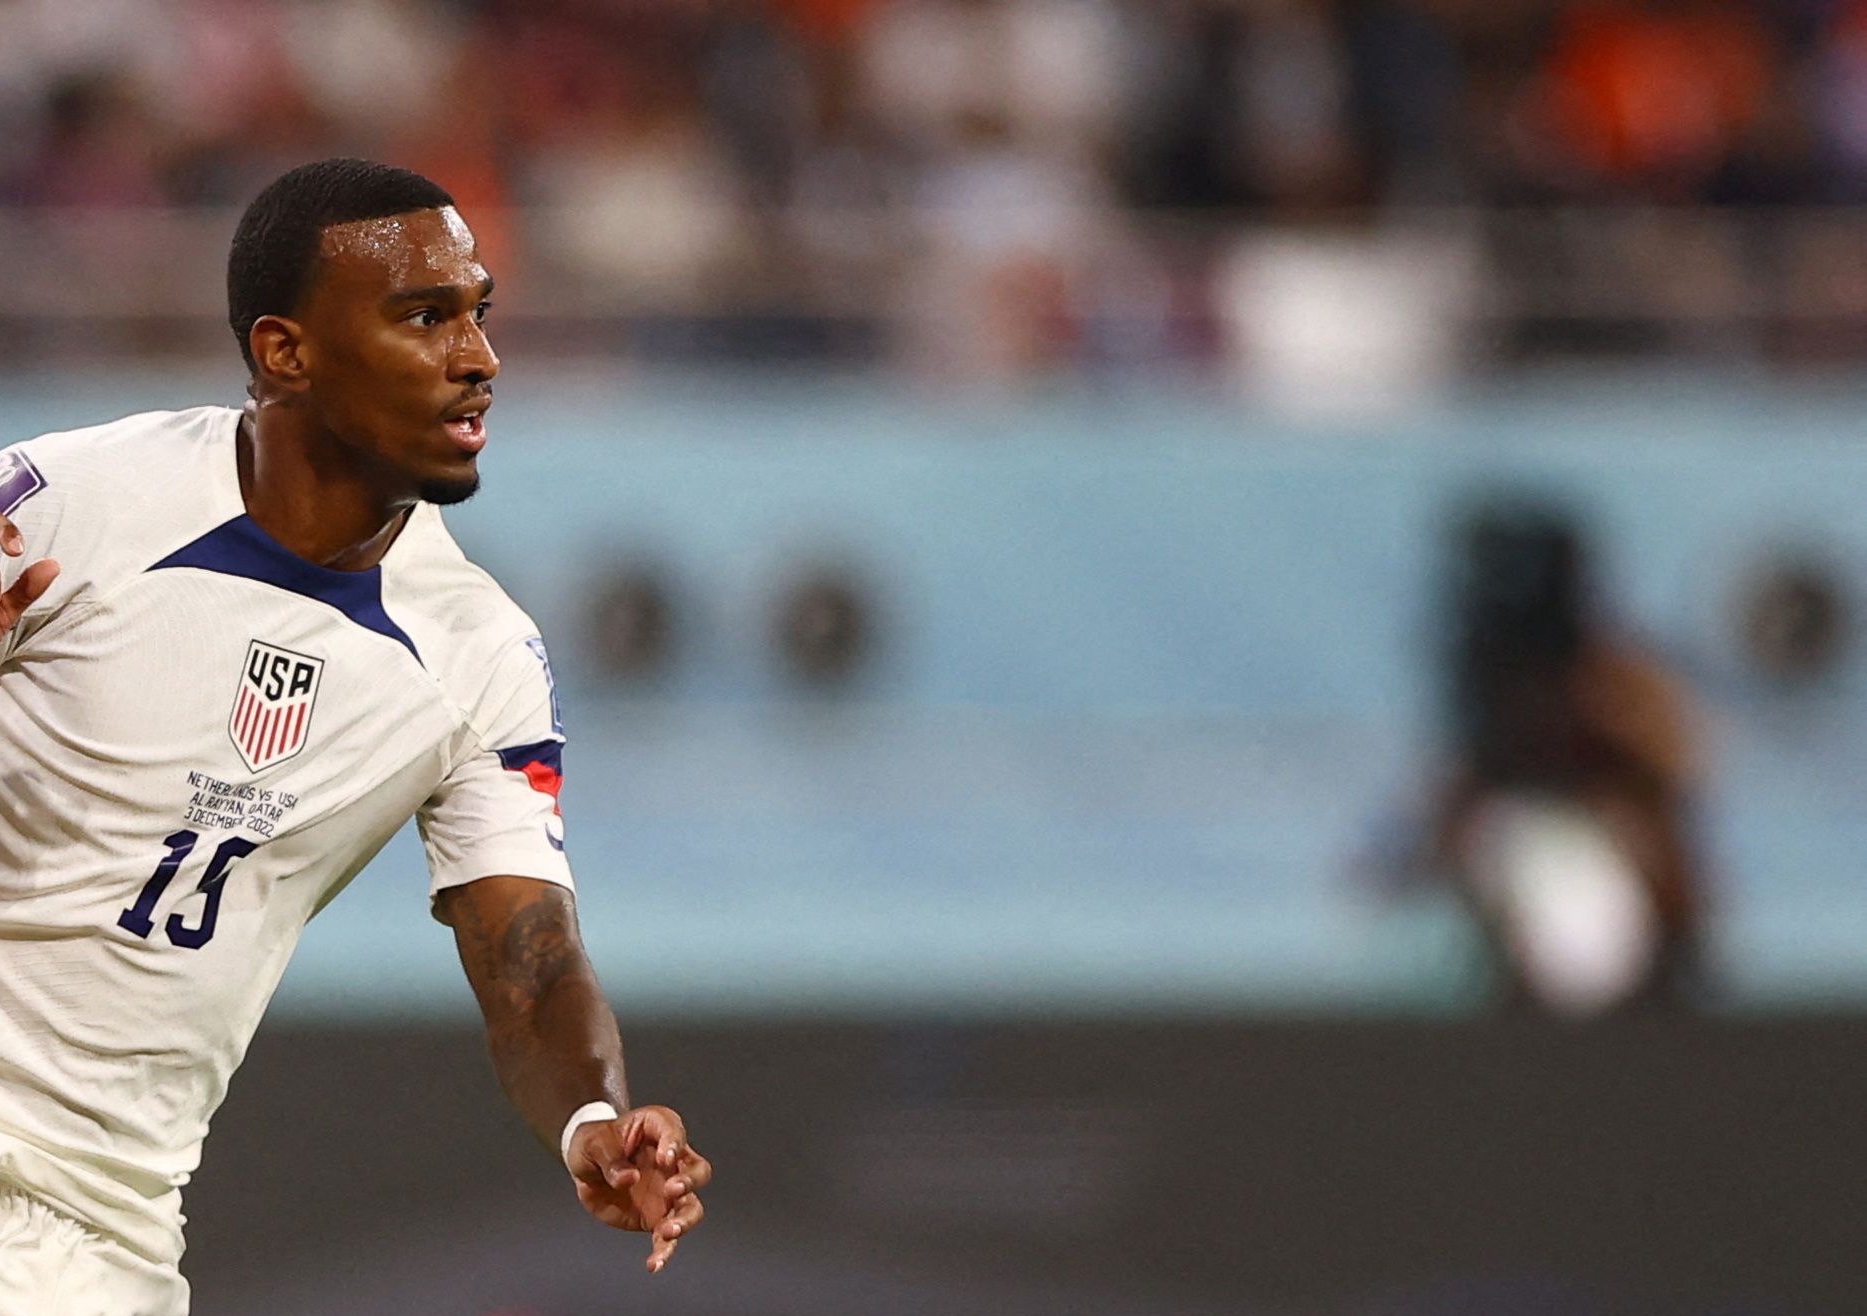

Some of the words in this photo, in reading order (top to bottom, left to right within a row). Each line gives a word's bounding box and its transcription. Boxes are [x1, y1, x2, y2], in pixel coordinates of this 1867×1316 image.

[248, 649, 315, 702] USA
[190, 792, 202, 806] AL
[184, 806, 194, 820] 3
[246, 816, 274, 838] 2022
[117, 829, 260, 950] 15
